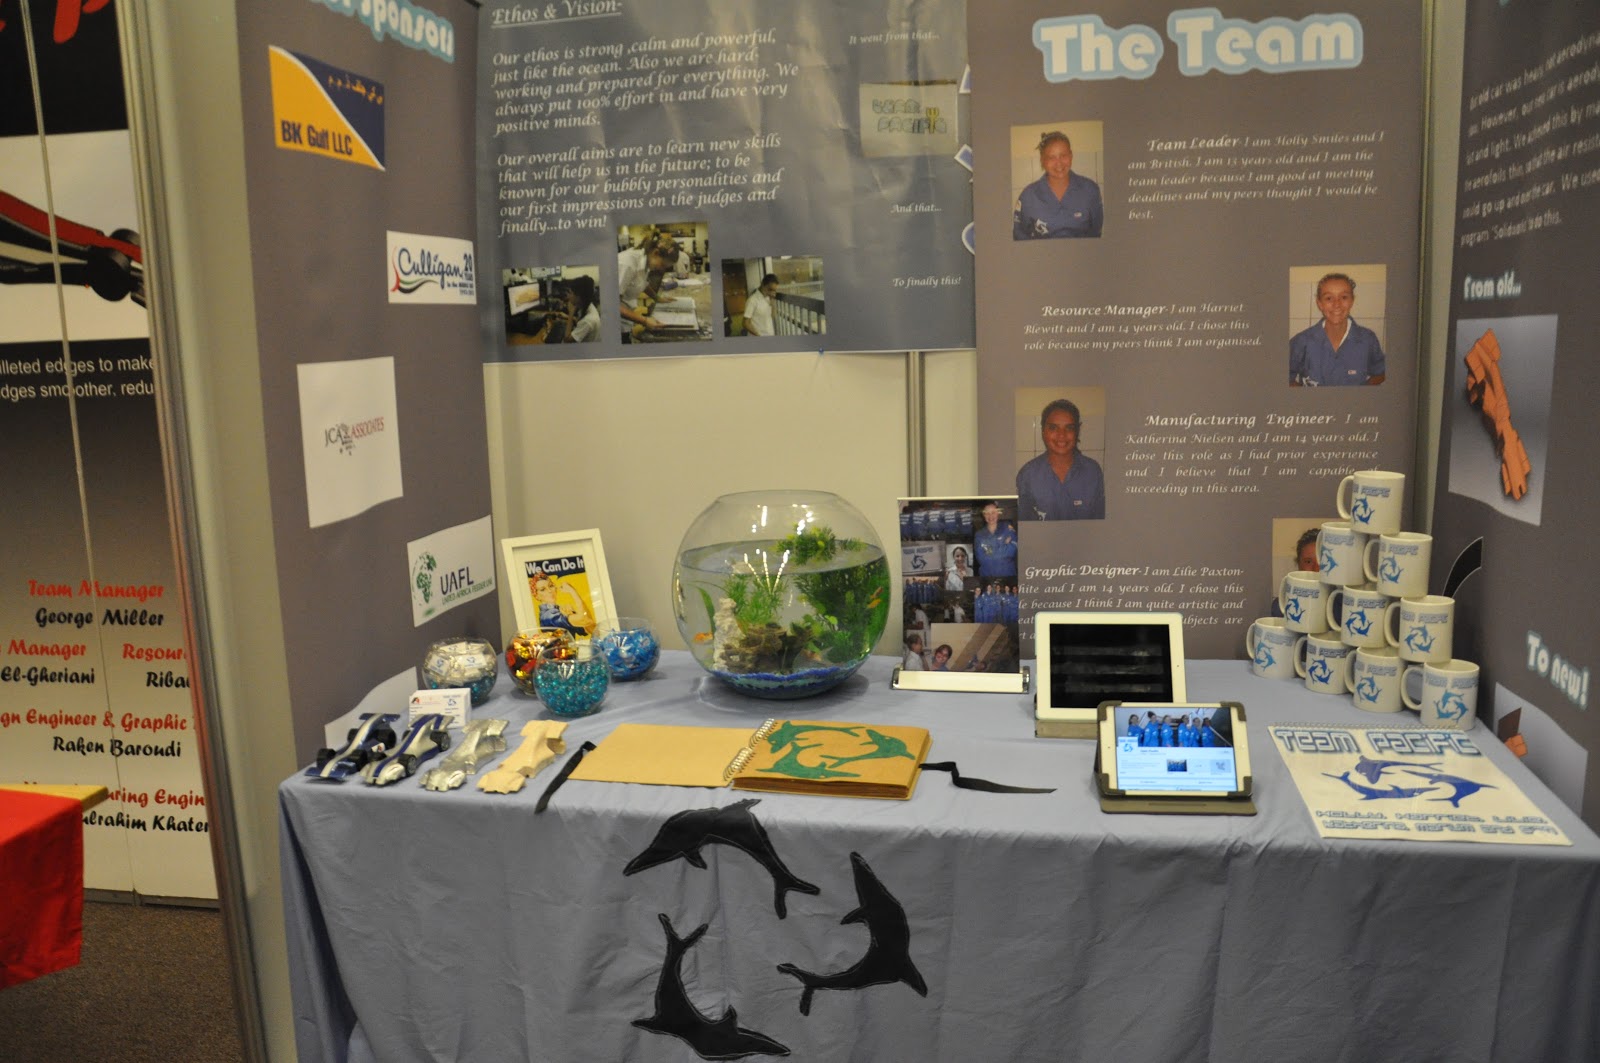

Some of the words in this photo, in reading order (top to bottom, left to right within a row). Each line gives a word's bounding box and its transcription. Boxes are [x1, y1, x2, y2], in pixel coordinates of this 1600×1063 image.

[492, 4, 538, 24] Ethos
[544, 3, 556, 20] &
[492, 53, 520, 65] Our
[524, 48, 559, 64] ethos
[564, 46, 574, 59] is
[579, 43, 624, 58] strong
[671, 32, 704, 50] and
[701, 28, 776, 52] powerful,
[849, 35, 856, 44] It
[859, 33, 882, 44] went
[884, 31, 908, 44] from
[912, 30, 940, 40] that...
[1040, 22, 1156, 75] The
[1175, 16, 1354, 68] Team
[491, 69, 518, 87] just
[524, 65, 548, 80] like
[552, 62, 574, 78] the
[578, 62, 622, 74] ocean.
[627, 54, 658, 70] Also
[664, 56, 684, 66] we
[688, 54, 713, 65] are
[496, 82, 552, 100] working
[556, 77, 586, 94] and
[584, 70, 656, 98] prepared
[654, 70, 680, 90] for
[684, 65, 769, 84] everything.
[776, 62, 798, 76] We
[496, 101, 544, 118] always
[546, 98, 572, 116] put
[577, 95, 610, 110] 100%
[614, 90, 654, 110] effort
[660, 90, 673, 102] in
[678, 84, 710, 101] and
[711, 82, 748, 98] have
[752, 83, 788, 99] very
[493, 117, 550, 138] positive
[554, 111, 600, 128] minds.
[281, 120, 302, 144] BK
[308, 126, 329, 150] Gulf
[332, 132, 352, 155] LLC
[1147, 139, 1186, 152] Team
[498, 154, 525, 166] Our
[528, 146, 580, 164] overall
[580, 148, 614, 160] aims
[620, 146, 642, 157] are
[648, 144, 662, 156] to
[666, 140, 704, 154] learn
[710, 140, 740, 152] new
[744, 133, 781, 149] skills
[499, 186, 545, 200] known
[548, 182, 570, 201] for
[574, 184, 599, 195] our
[604, 176, 651, 195] bubbly
[653, 170, 748, 194] personalities
[752, 168, 785, 184] and
[890, 203, 914, 213] And
[915, 203, 942, 212] that...
[1128, 208, 1154, 220] best.
[498, 218, 572, 238] finally...to
[577, 215, 606, 228] win!
[398, 248, 463, 290] Culligan
[893, 278, 904, 287] To
[905, 276, 938, 288] finally
[941, 276, 962, 285] this!
[1464, 276, 1494, 300] From
[1042, 306, 1101, 316] Resource
[1103, 304, 1168, 318] Manager-
[1170, 304, 1176, 314] I
[1200, 302, 1244, 312] Harriet
[1206, 336, 1262, 349] organised.
[99, 358, 113, 372] to
[0, 384, 36, 402] dges
[1144, 413, 1256, 428] Manufacturing
[1345, 414, 1352, 424] I
[1359, 416, 1378, 424] am
[325, 428, 344, 447] JCA
[1126, 433, 1186, 444] Katherina
[1313, 450, 1378, 462] experience
[1126, 482, 1188, 496] succeeding
[1208, 482, 1228, 492] this
[1231, 484, 1259, 492] area.
[526, 562, 542, 574] We
[542, 561, 562, 572] Can
[561, 558, 576, 570] Do
[1026, 564, 1077, 580] Graphic
[1080, 564, 1141, 578] Designer-
[1144, 567, 1150, 576] I
[1172, 566, 1197, 576] Lilie
[1200, 566, 1244, 576] Paxton-
[440, 566, 474, 595] UAFL
[1044, 582, 1067, 592] and
[1070, 584, 1075, 592] I
[1102, 585, 1113, 594] 14
[1119, 585, 1149, 595] years
[1154, 582, 1174, 592] old.
[1179, 584, 1185, 593] I
[1190, 582, 1218, 593] chose
[1224, 582, 1244, 592] this
[28, 580, 73, 598] Team
[78, 580, 164, 602] Manager
[36, 608, 94, 628] George
[102, 609, 164, 626] Miller
[8, 639, 86, 661] Manager
[0, 666, 94, 686] El-Gheriani
[1528, 634, 1549, 673] To
[1551, 658, 1588, 705] new!
[26, 708, 97, 729] Engineer
[103, 711, 115, 728] &
[120, 712, 188, 733] Graphic
[53, 736, 104, 756] Raken
